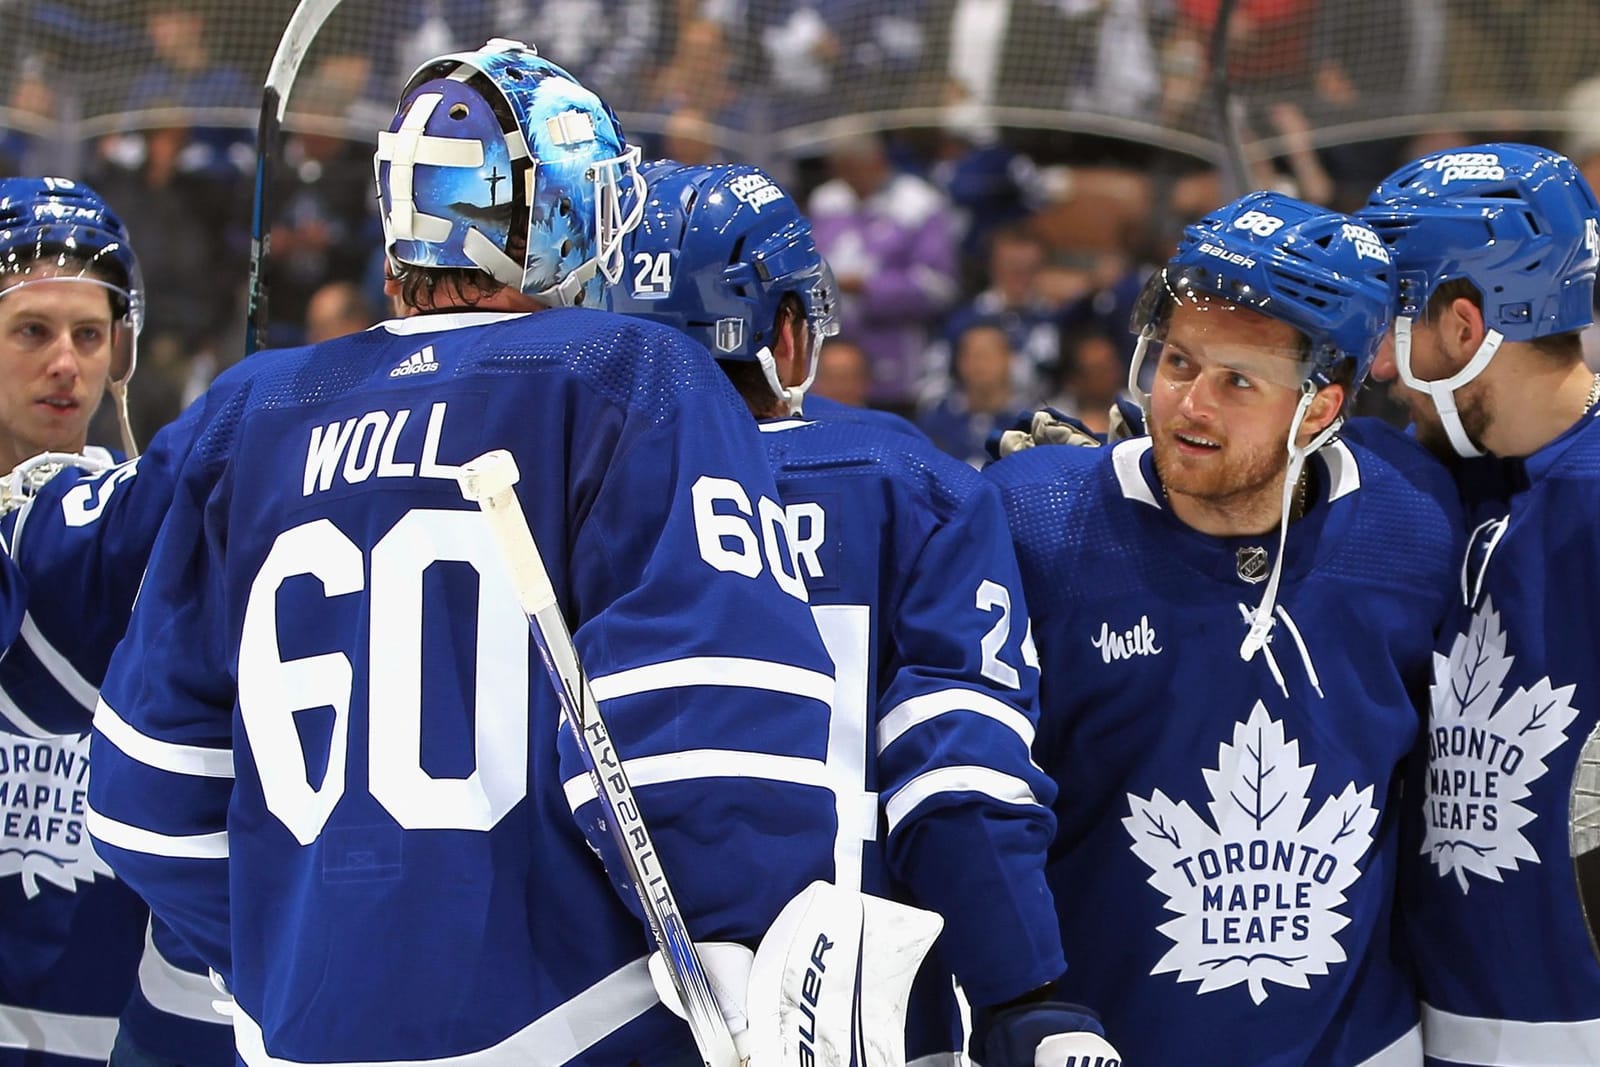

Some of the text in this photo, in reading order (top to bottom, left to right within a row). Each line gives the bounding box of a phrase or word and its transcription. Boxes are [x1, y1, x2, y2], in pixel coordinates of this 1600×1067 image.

[1436, 153, 1499, 172] pizza
[1442, 165, 1505, 186] pizza
[1234, 210, 1285, 237] 88
[1198, 243, 1257, 269] BAUER
[633, 252, 672, 293] 24
[388, 358, 440, 377] adidas
[302, 401, 463, 497] WOLL
[690, 475, 810, 604] 60
[1091, 614, 1164, 664] Milk
[237, 508, 531, 847] 60
[0, 744, 90, 786] ORONT
[1430, 767, 1499, 798] MAPLE
[4, 812, 82, 845] EAFS
[1432, 800, 1498, 831] LEAFS
[1173, 839, 1338, 888] TORONTO
[1203, 882, 1312, 911] MAPLE
[1202, 914, 1310, 944] LEAFS
[799, 932, 835, 1067] AUER
